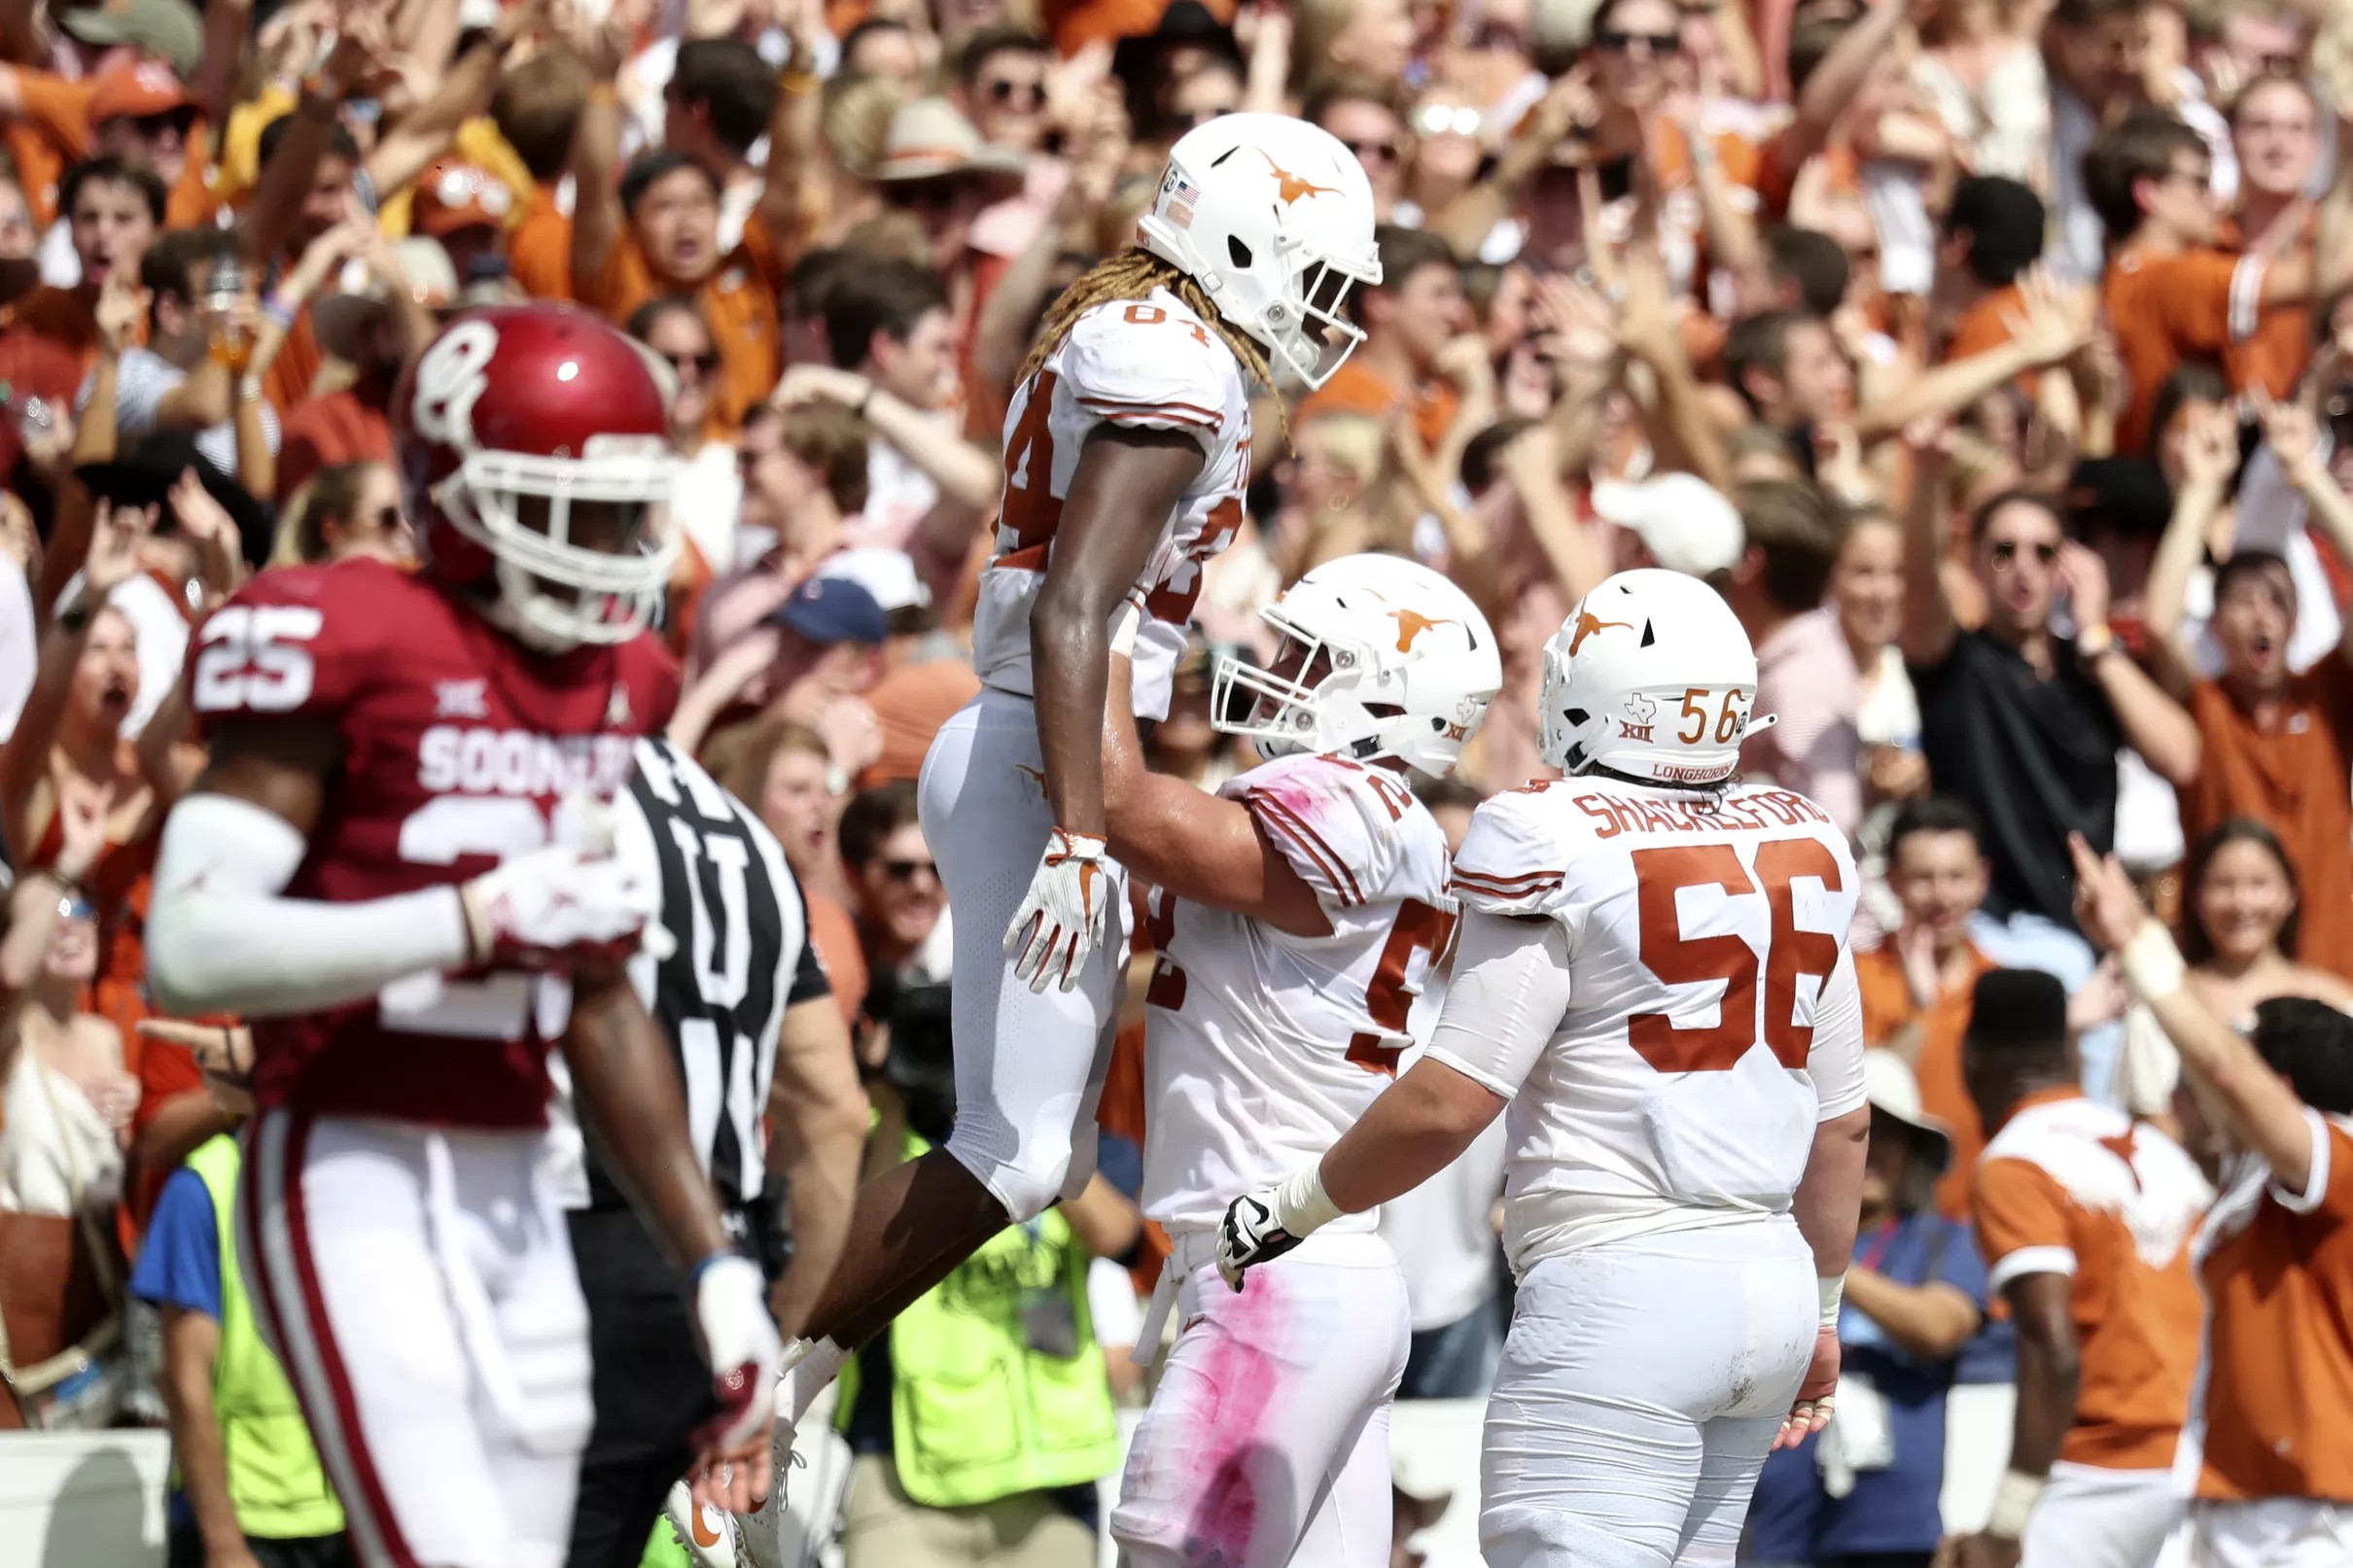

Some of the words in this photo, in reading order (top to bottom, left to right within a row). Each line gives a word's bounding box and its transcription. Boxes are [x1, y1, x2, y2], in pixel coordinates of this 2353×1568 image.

[194, 605, 323, 712] 25
[1618, 718, 1656, 745] XII
[1677, 687, 1743, 746] 56
[1628, 837, 1844, 1073] 56
